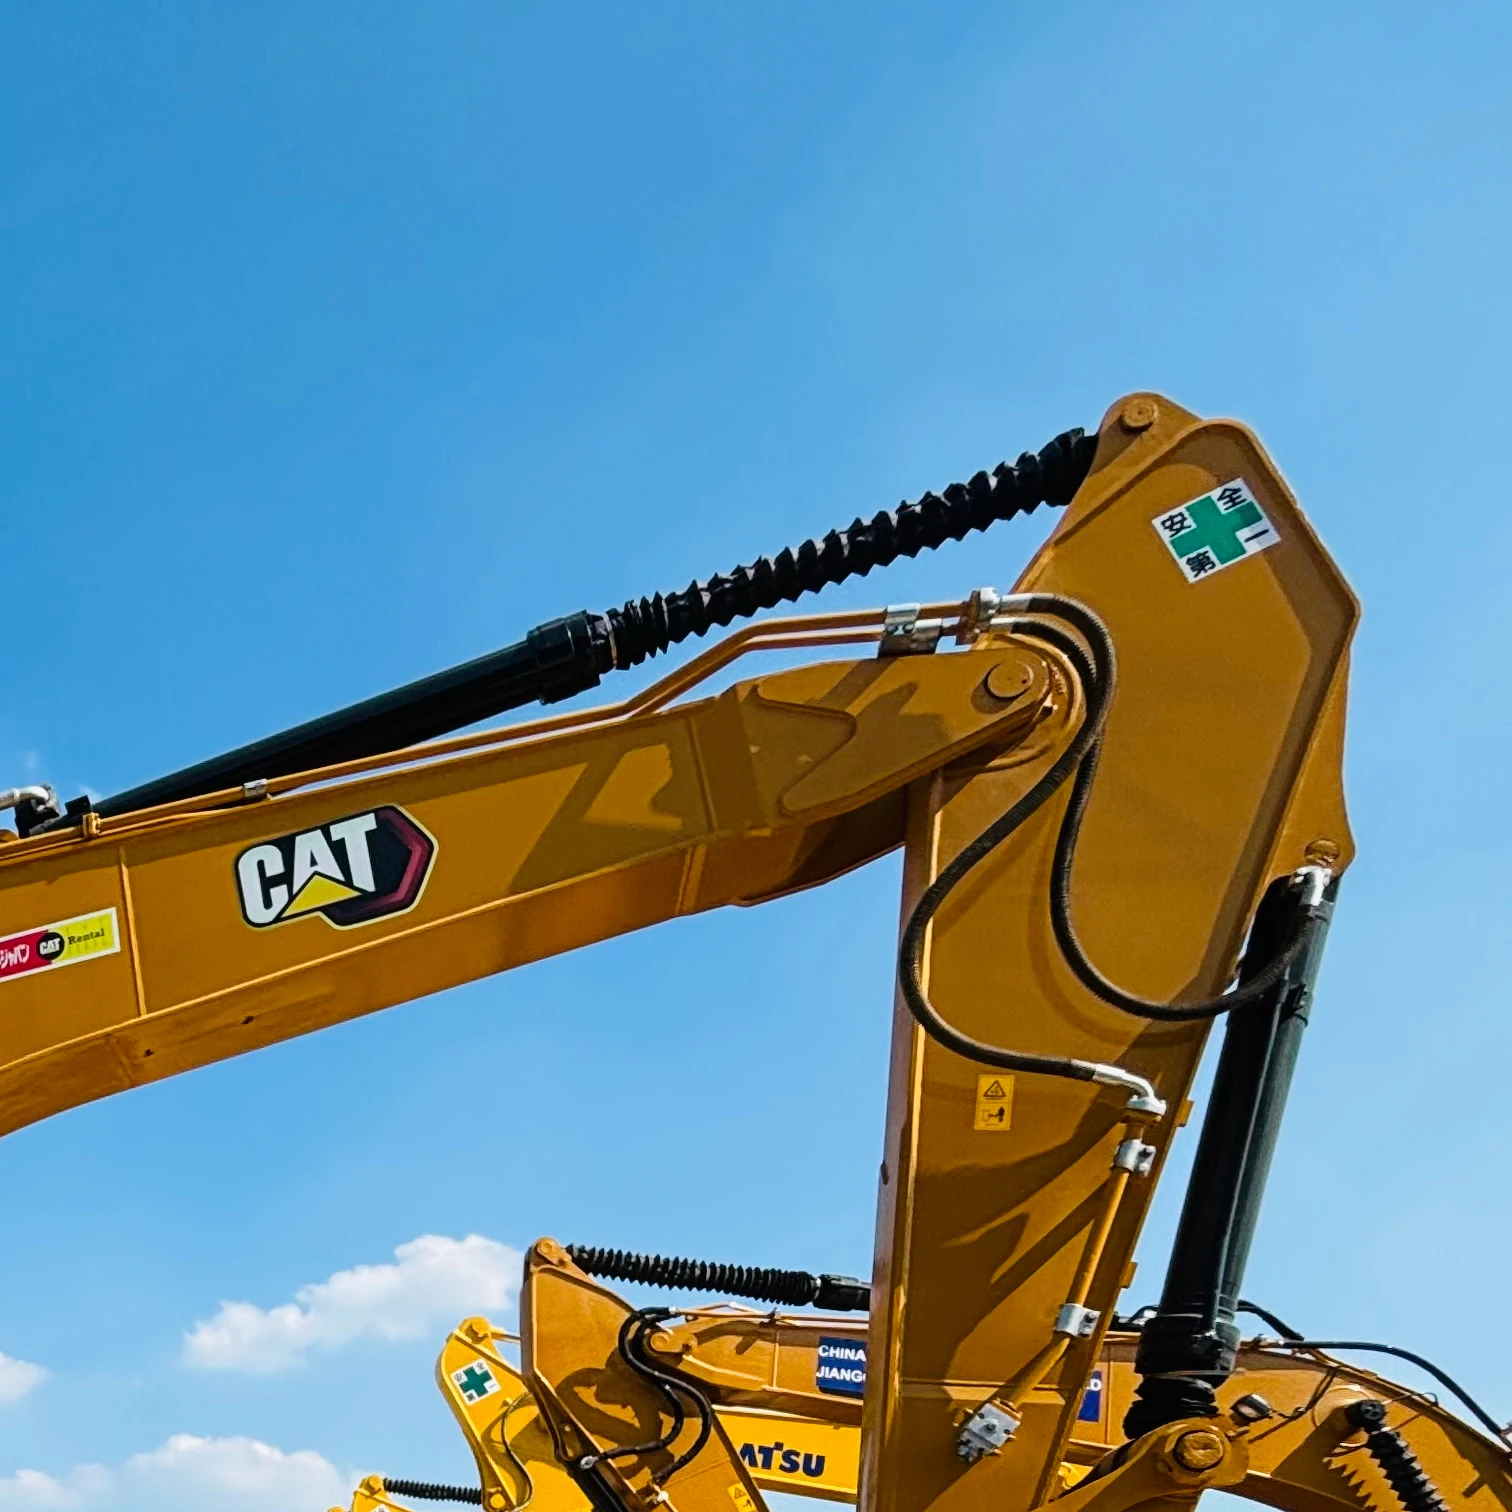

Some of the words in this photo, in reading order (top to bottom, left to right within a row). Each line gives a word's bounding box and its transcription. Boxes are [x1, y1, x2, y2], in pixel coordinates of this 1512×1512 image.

[238, 812, 378, 925] CAT
[38, 936, 62, 956] CAT
[67, 927, 106, 946] Rental
[818, 1344, 868, 1362] CHINA
[815, 1365, 867, 1383] JIANG
[739, 1441, 826, 1478] ATSU
